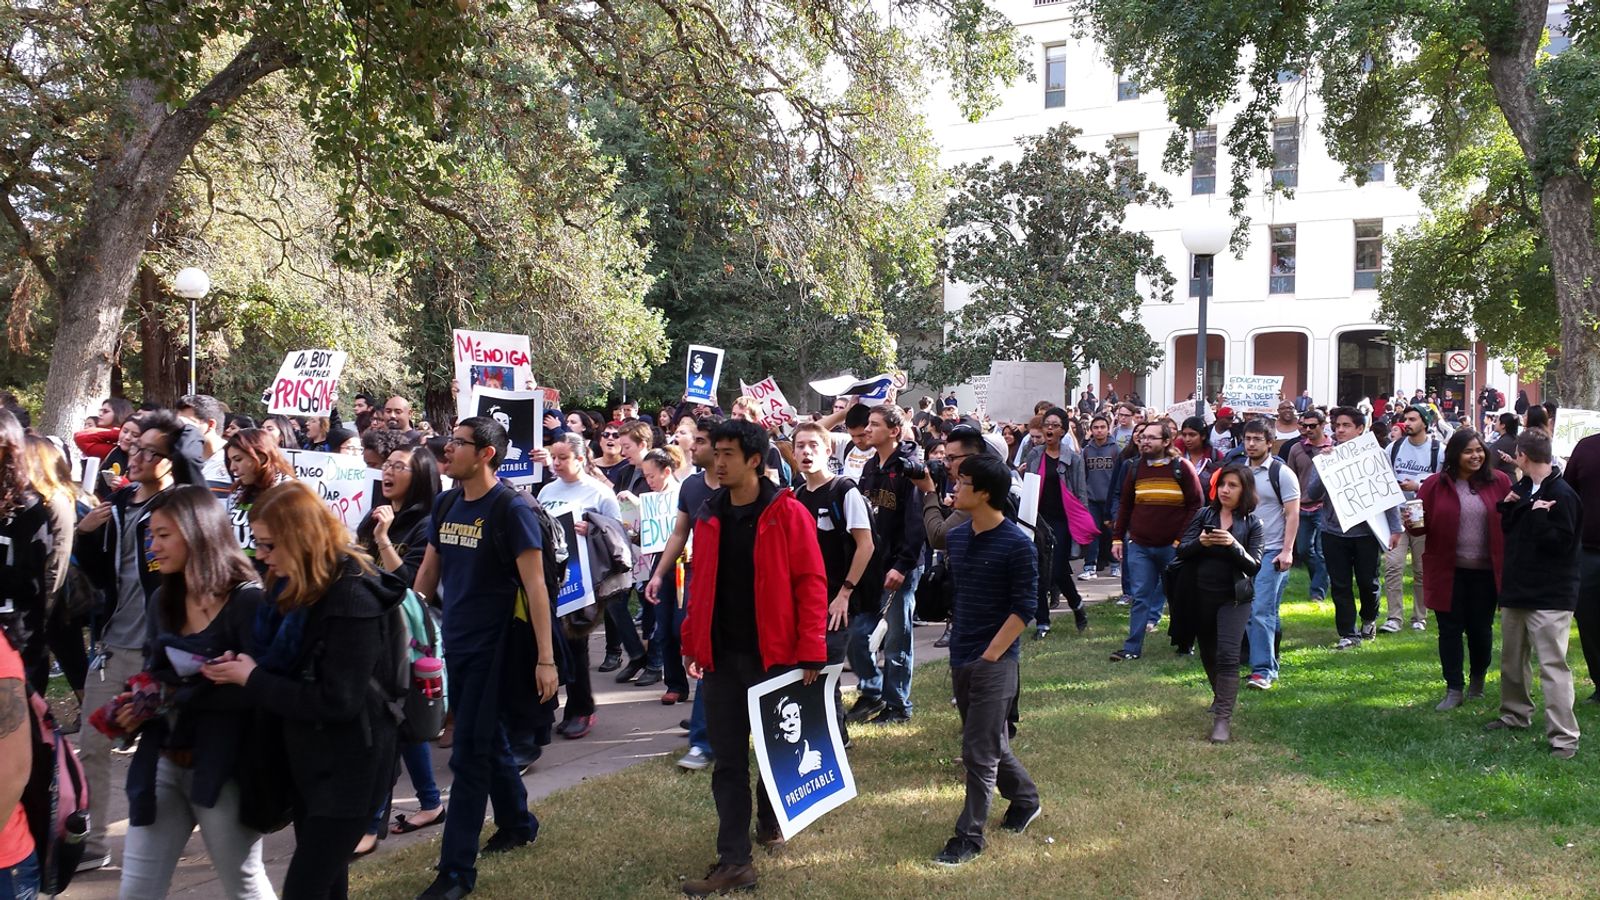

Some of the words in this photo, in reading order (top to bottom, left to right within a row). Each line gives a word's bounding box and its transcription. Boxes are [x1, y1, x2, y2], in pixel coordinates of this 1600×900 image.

[274, 378, 336, 411] PRISON
[770, 398, 782, 411] A
[440, 522, 482, 539] ALIFORNIA
[785, 769, 836, 807] PREDICTABLE
